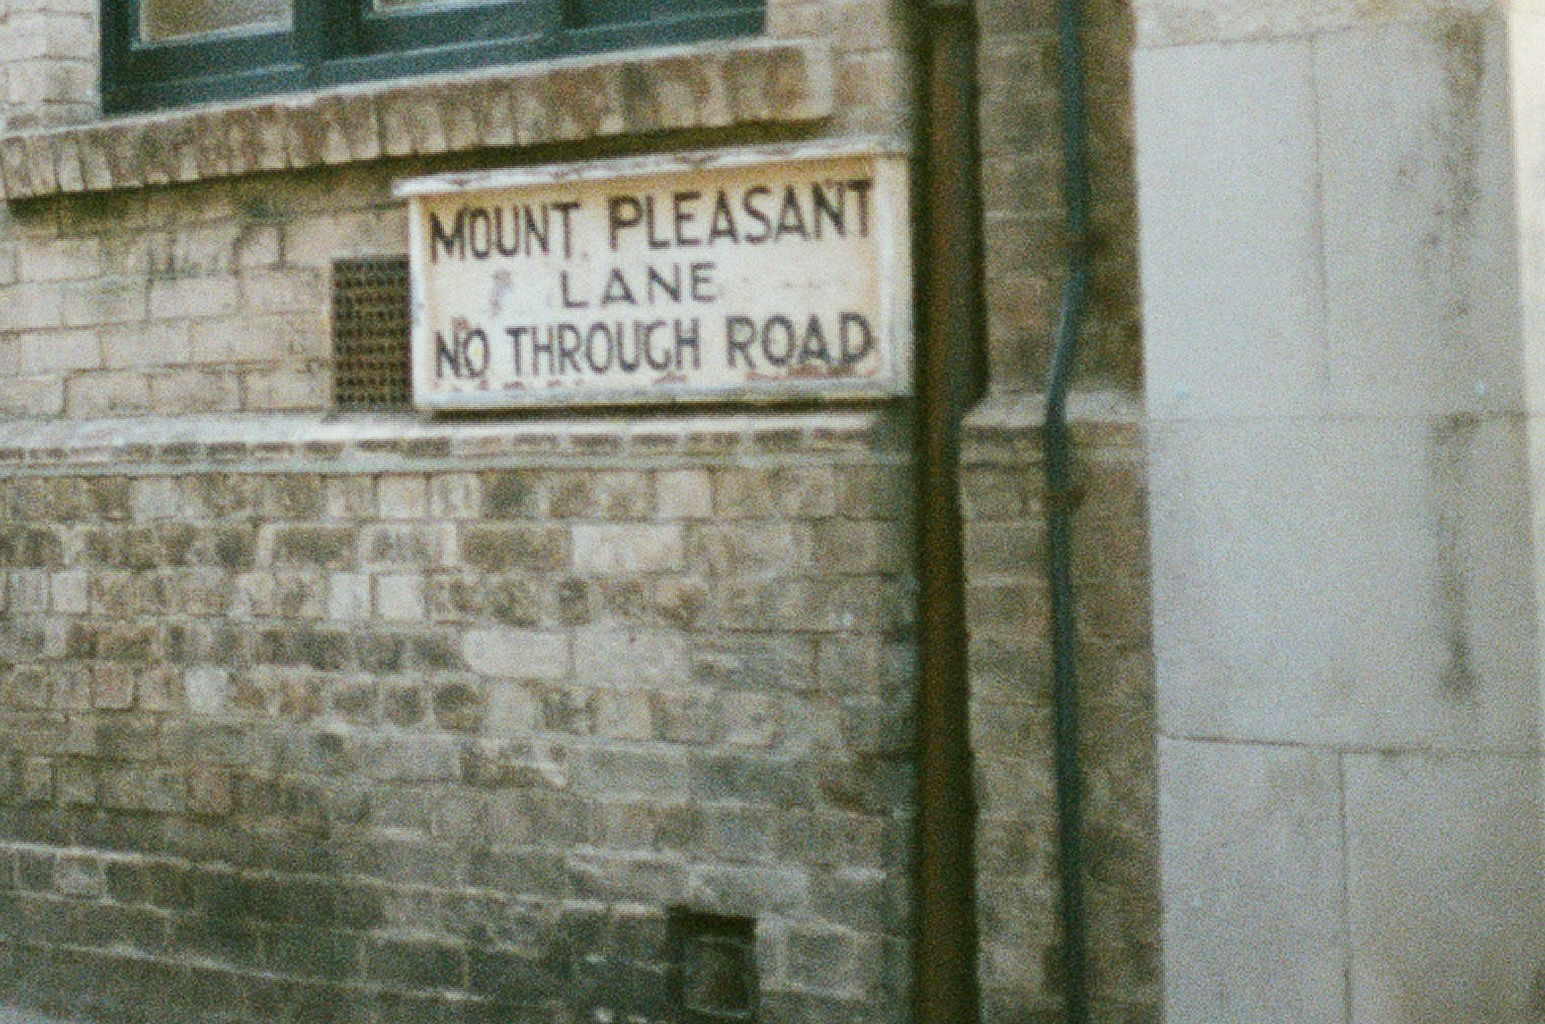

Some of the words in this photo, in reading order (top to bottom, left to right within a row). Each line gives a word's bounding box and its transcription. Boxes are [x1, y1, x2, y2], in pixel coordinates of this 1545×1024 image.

[428, 200, 581, 264] MOUNT
[608, 178, 873, 251] PLEASANT
[561, 262, 718, 308] LANE
[434, 328, 489, 378] NO
[506, 318, 701, 376] THROUGH
[726, 312, 873, 369] ROAD
